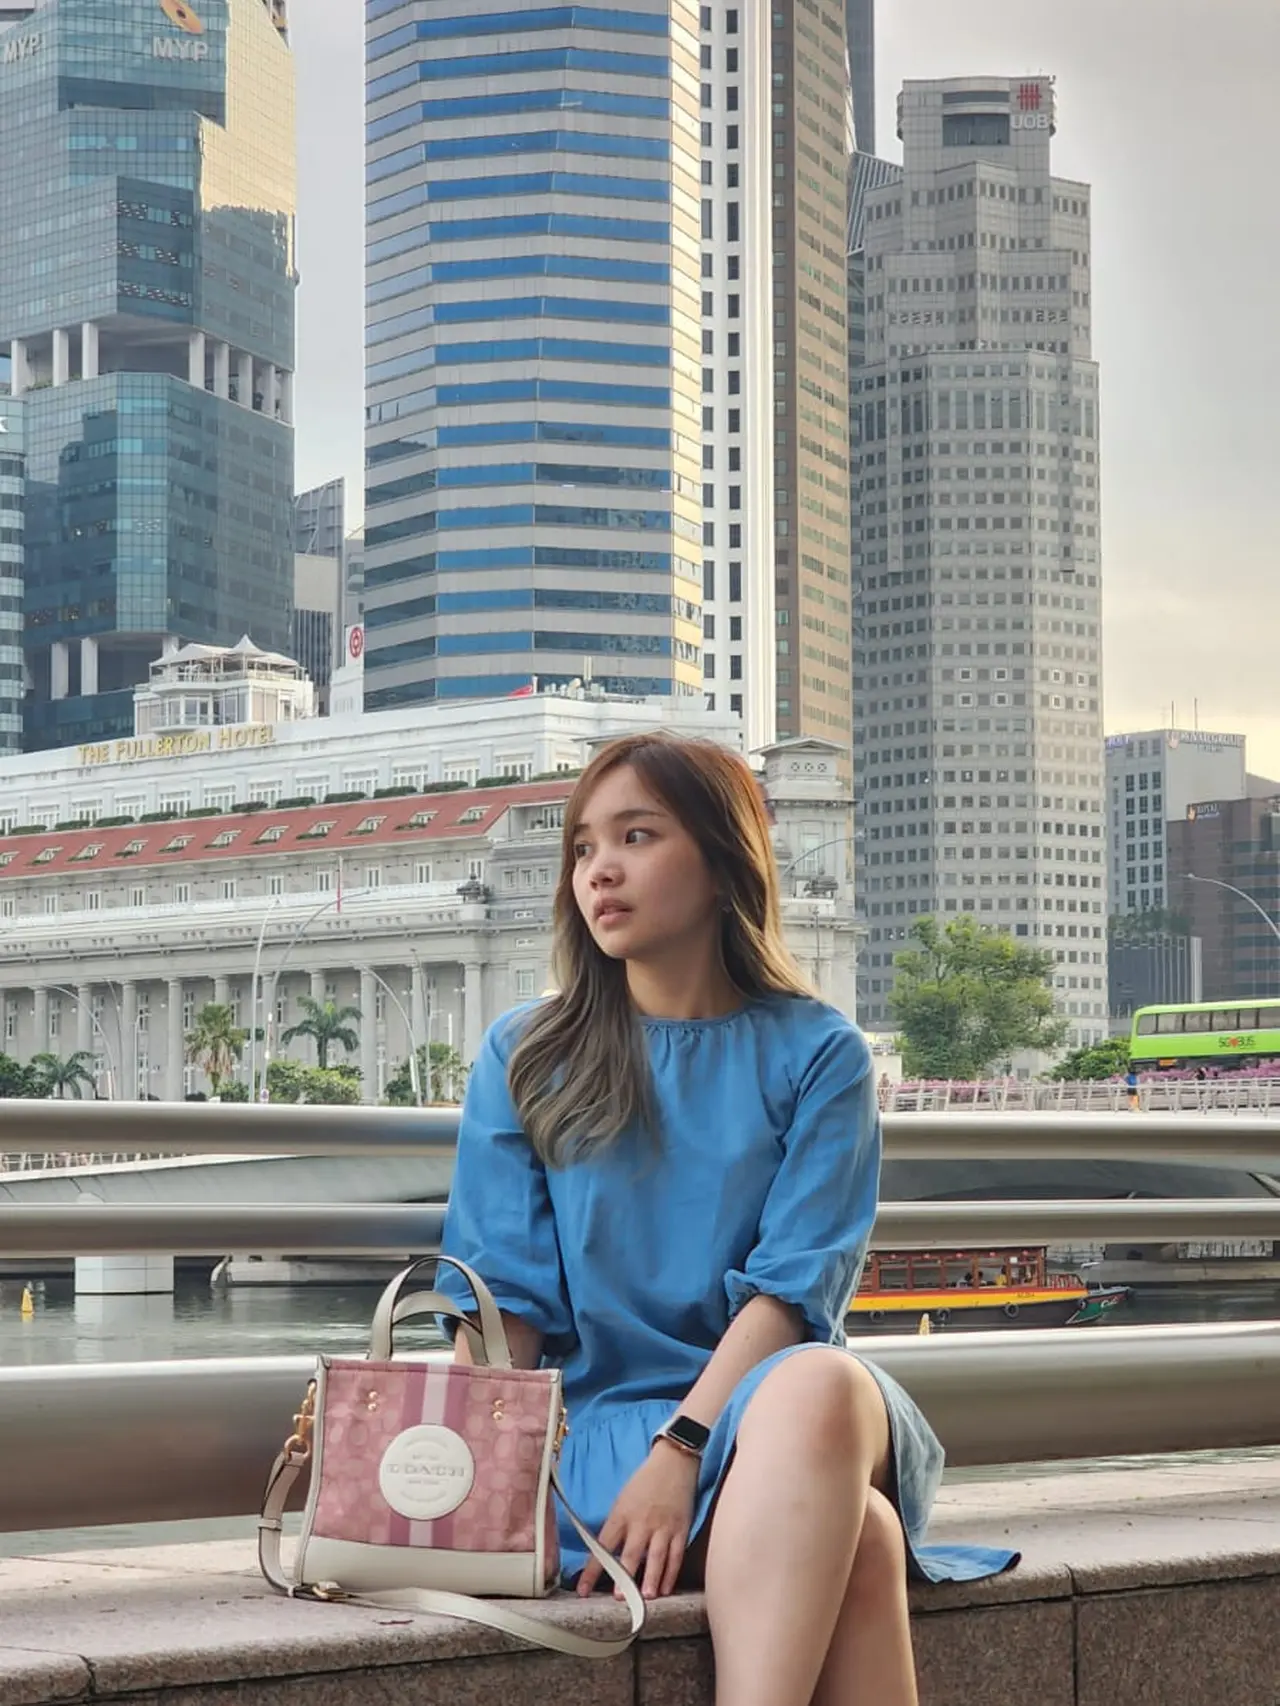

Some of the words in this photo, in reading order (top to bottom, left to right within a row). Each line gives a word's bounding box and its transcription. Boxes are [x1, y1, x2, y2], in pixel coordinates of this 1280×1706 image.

[3, 33, 43, 64] MYP
[152, 36, 209, 61] MYP
[1010, 114, 1049, 129] UOB
[78, 745, 109, 765] THE
[115, 733, 211, 761] FULLERTON
[219, 724, 276, 748] HOTEL
